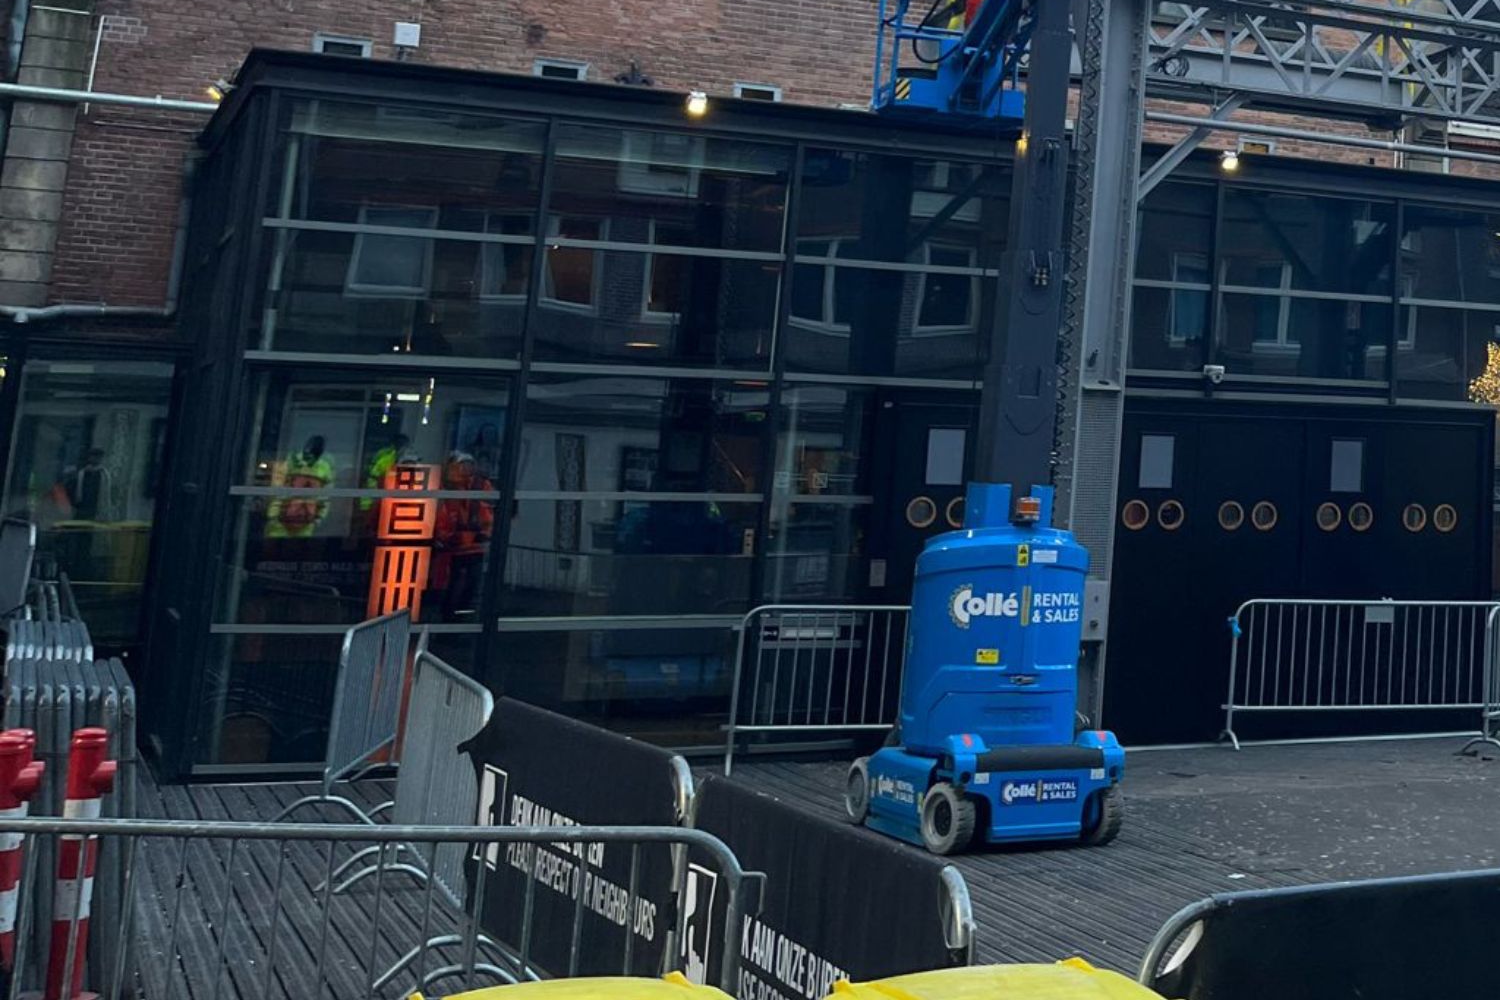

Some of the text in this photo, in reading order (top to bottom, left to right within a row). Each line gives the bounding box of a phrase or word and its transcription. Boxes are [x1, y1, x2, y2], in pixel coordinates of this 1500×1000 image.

[951, 587, 1079, 624] Collé RENTAL
[1032, 608, 1079, 623] & SALES
[1042, 782, 1077, 791] RENTAL
[1050, 790, 1077, 800] SALES
[535, 846, 574, 896] RESPECT
[571, 865, 592, 907] OR
[591, 875, 657, 942] NEIGHBURS
[750, 919, 776, 975] AAN
[775, 933, 807, 994] ONZE
